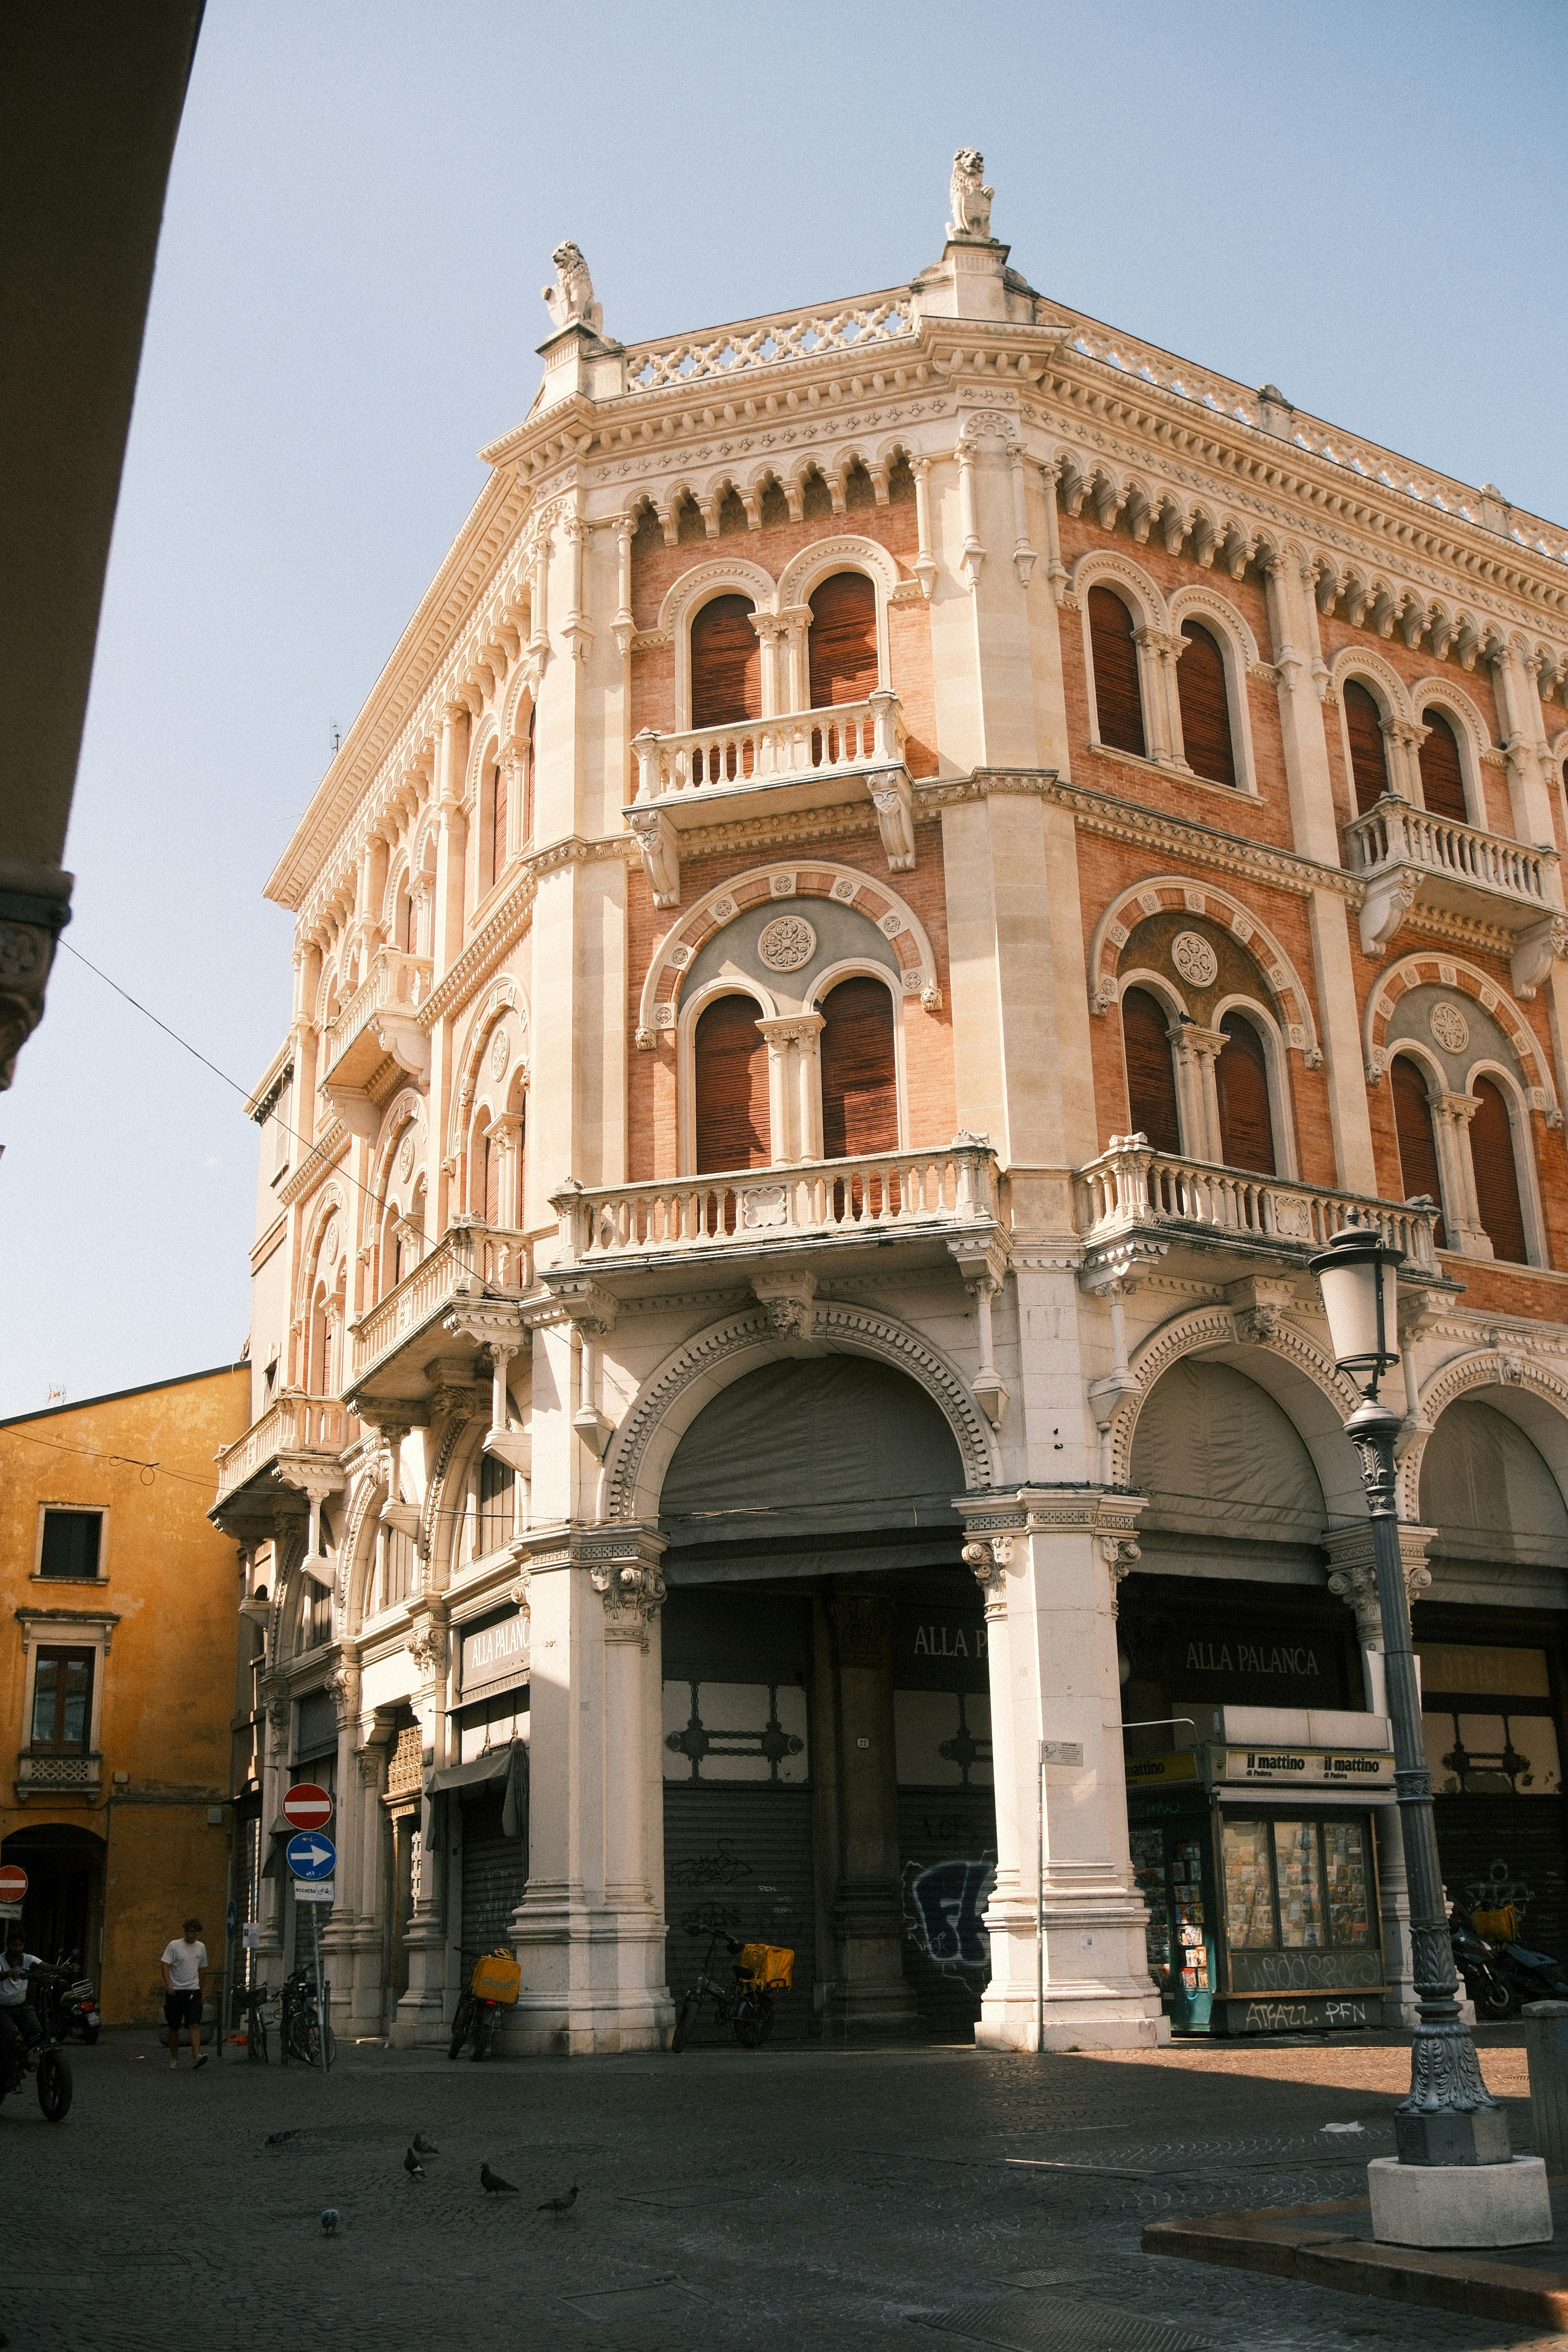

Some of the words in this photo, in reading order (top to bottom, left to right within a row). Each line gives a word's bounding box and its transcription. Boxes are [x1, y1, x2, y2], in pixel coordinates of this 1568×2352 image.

[472, 1632, 493, 1669] ALLA
[495, 1617, 530, 1659] PALANC
[914, 1625, 969, 1657] ALLA
[1186, 1642, 1234, 1671] ALLA
[1237, 1645, 1320, 1675] PALANCA
[1247, 1753, 1255, 1768] il
[1258, 1755, 1305, 1770] mattino
[1324, 1756, 1332, 1770] il
[1334, 1758, 1380, 1773] mattino
[482, 1976, 511, 1990] Glovo
[1325, 2002, 1366, 2024] PFN
